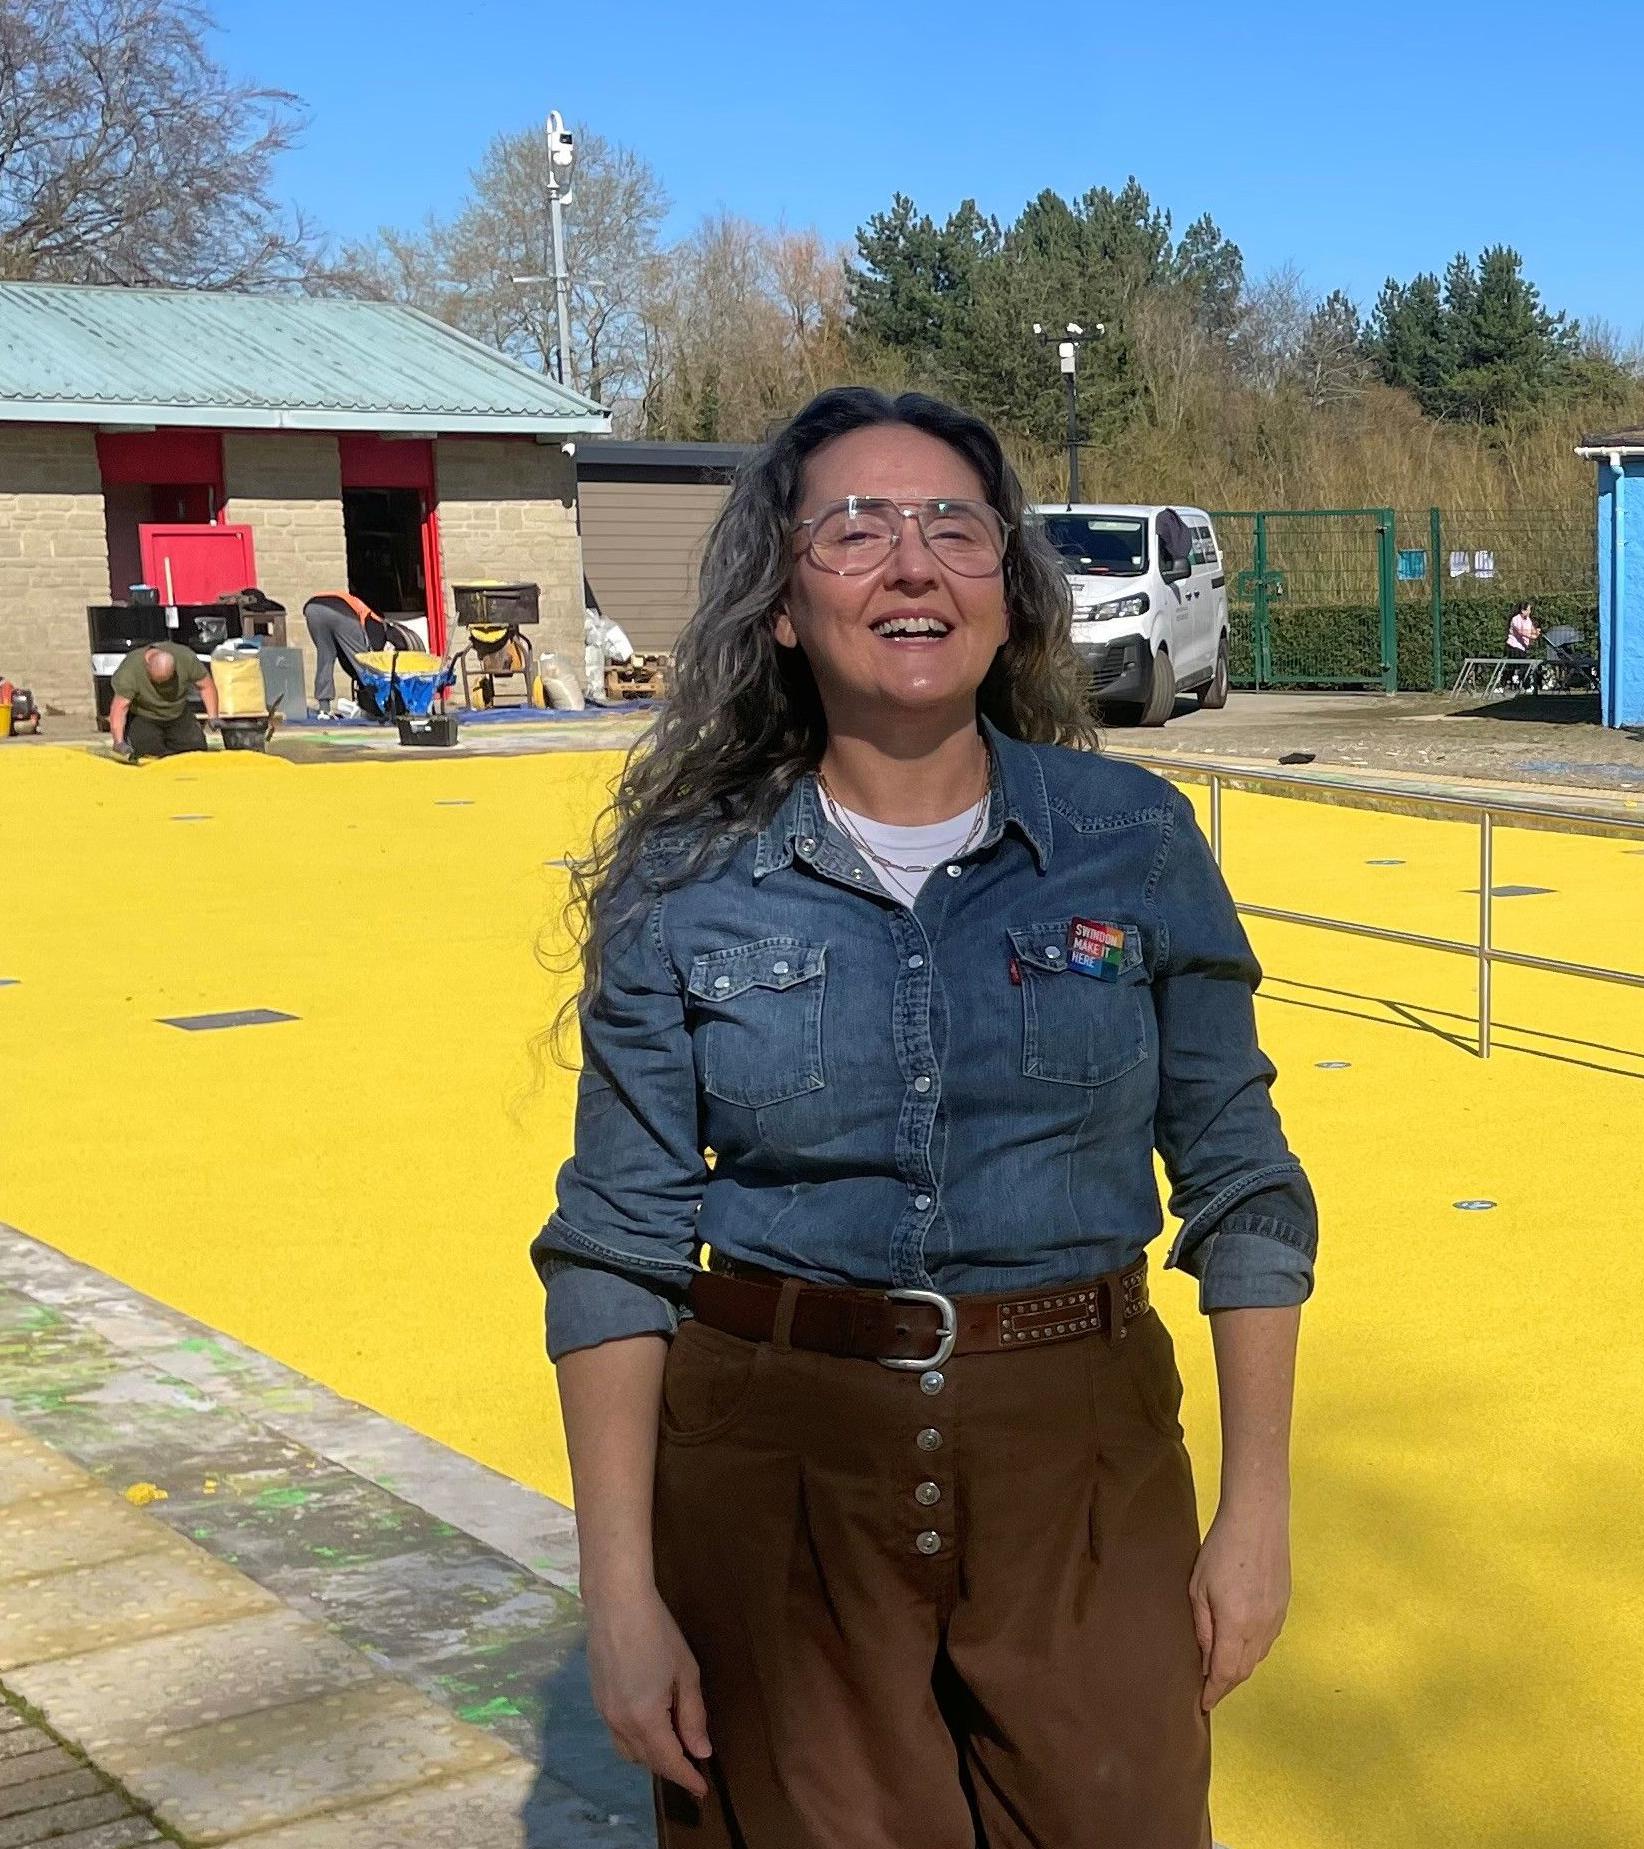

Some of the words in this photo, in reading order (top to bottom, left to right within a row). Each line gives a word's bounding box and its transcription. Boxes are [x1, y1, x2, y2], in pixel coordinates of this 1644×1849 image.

[1075, 924, 1118, 946] SWINDON
[1073, 937, 1101, 956] MAKE
[1101, 945, 1110, 958] IT
[1071, 951, 1096, 968] HERE
